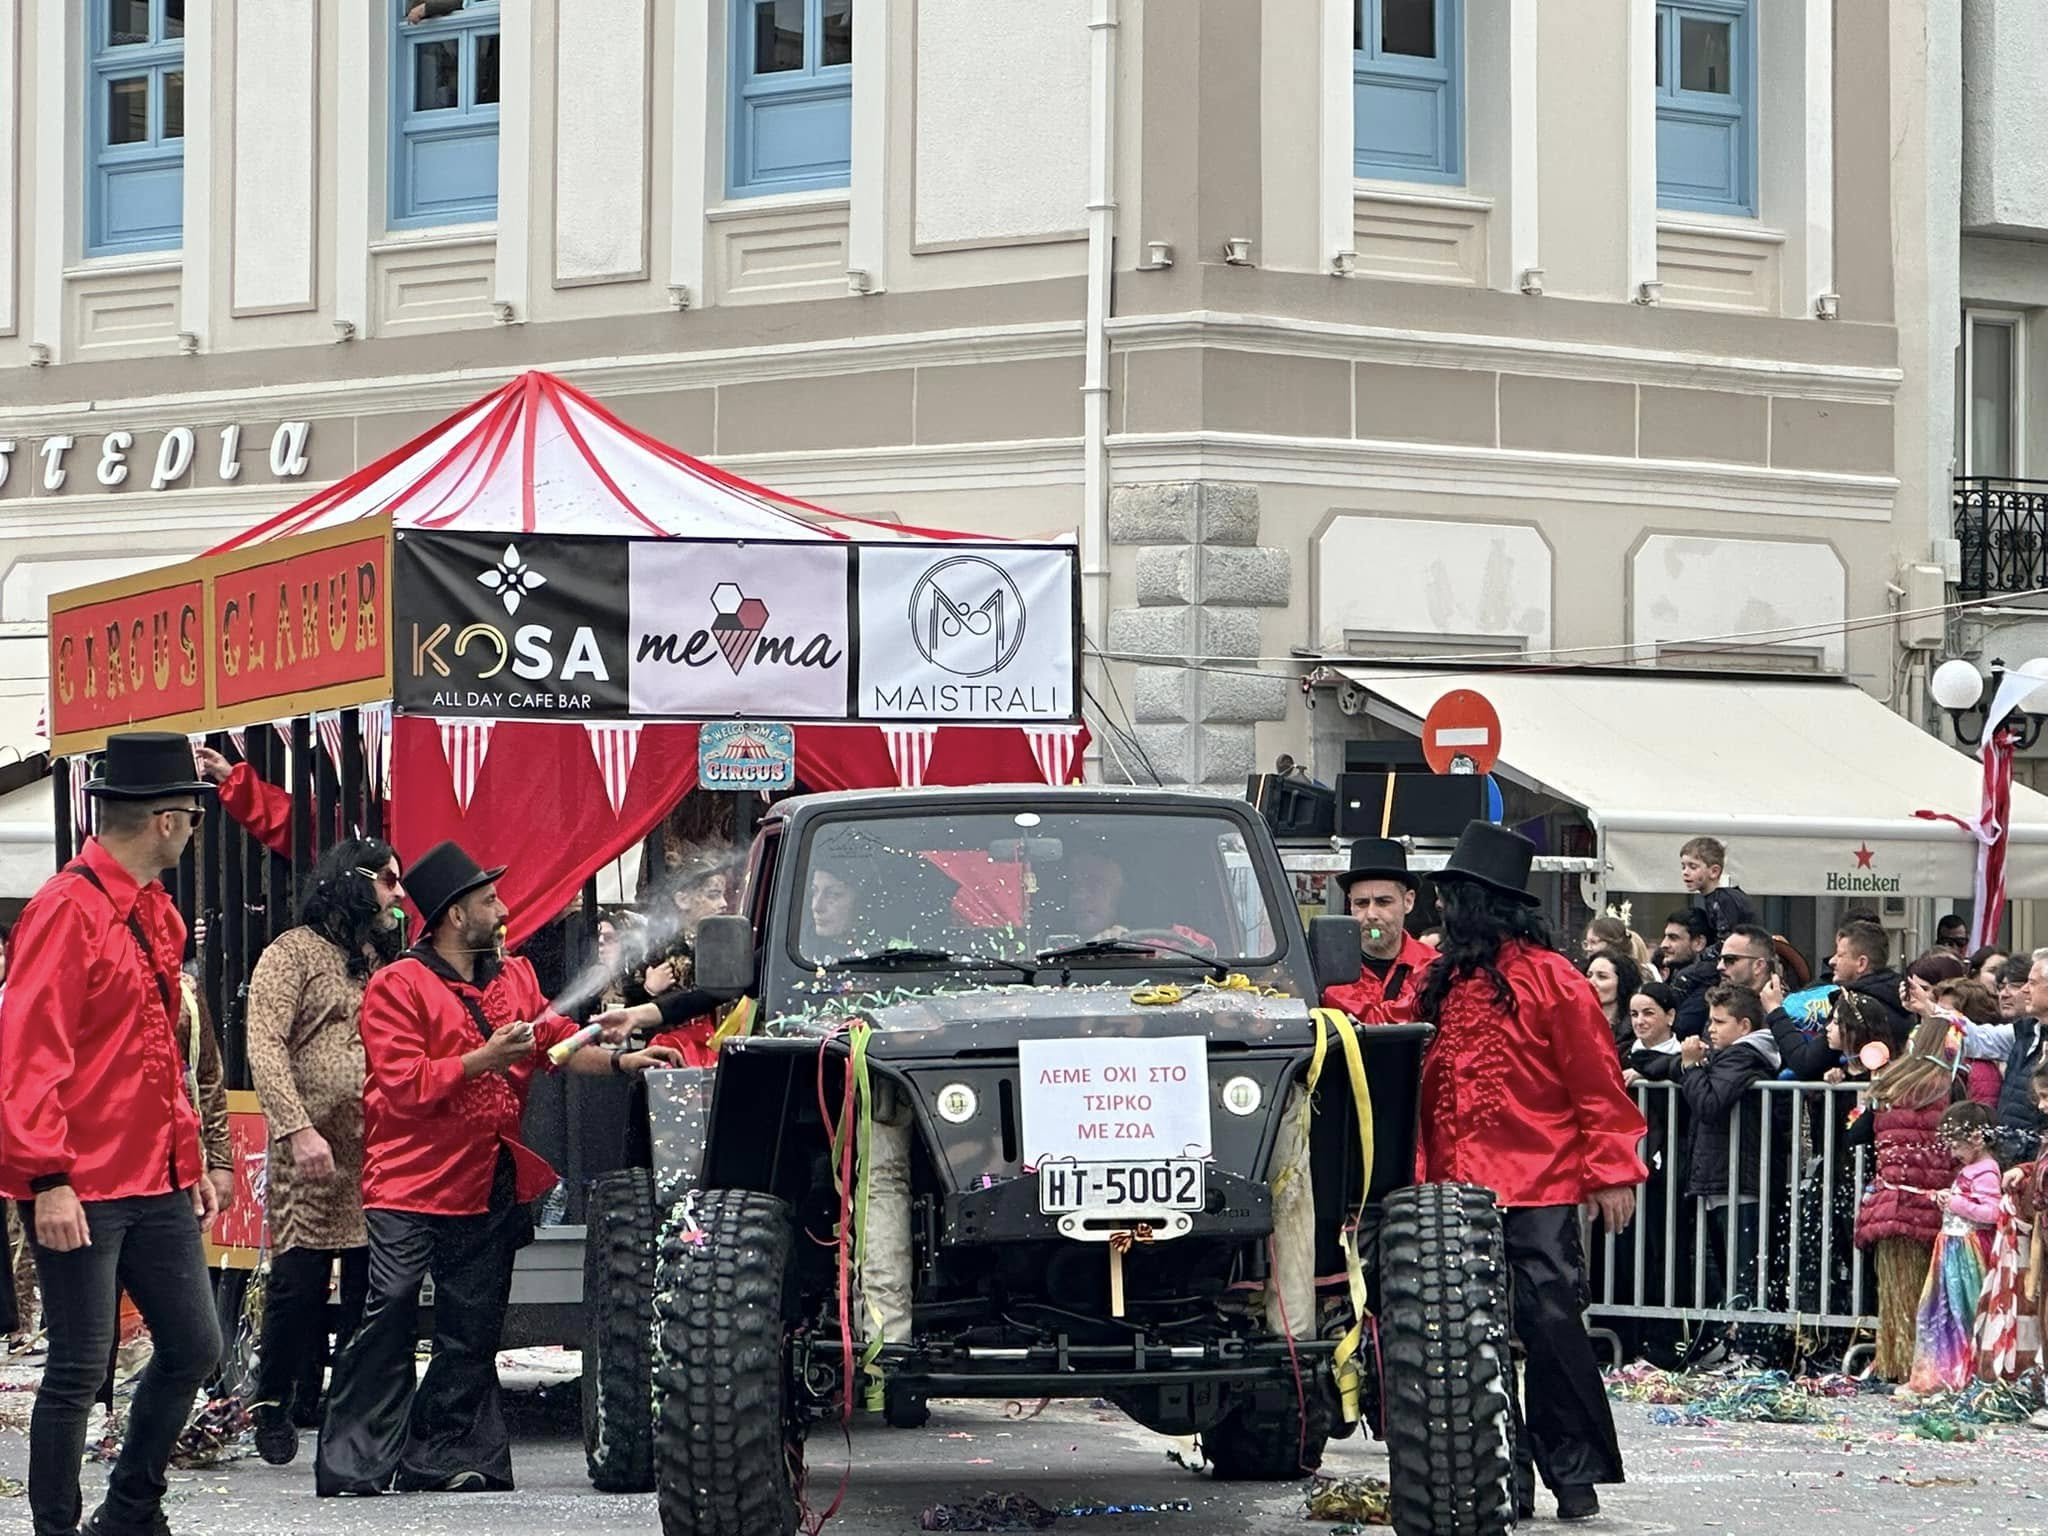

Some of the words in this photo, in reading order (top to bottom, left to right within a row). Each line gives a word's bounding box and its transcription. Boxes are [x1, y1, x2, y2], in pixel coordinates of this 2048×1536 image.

[58, 604, 198, 705] CIRCUS
[222, 560, 378, 678] GLAMUR
[412, 622, 610, 682] KOSA
[432, 691, 462, 707] ALL
[466, 693, 503, 708] DAY
[508, 693, 554, 709] CAFE
[558, 693, 591, 709] BAR
[875, 684, 1057, 713] MAISTRALI
[705, 760, 786, 781] CIRCUS
[1826, 871, 1900, 892] Heineken
[1039, 1067, 1092, 1084] ΛΕΜΕ
[1103, 1066, 1137, 1083] ΟΧΙ
[1149, 1065, 1187, 1083] ΣΤΟ
[1083, 1094, 1153, 1111] ΤΣΙΡΚΟ
[1077, 1123, 1109, 1140] ΜΕ
[1114, 1122, 1155, 1139] ΖΩΑ
[1049, 1165, 1197, 1207] HT-5002
